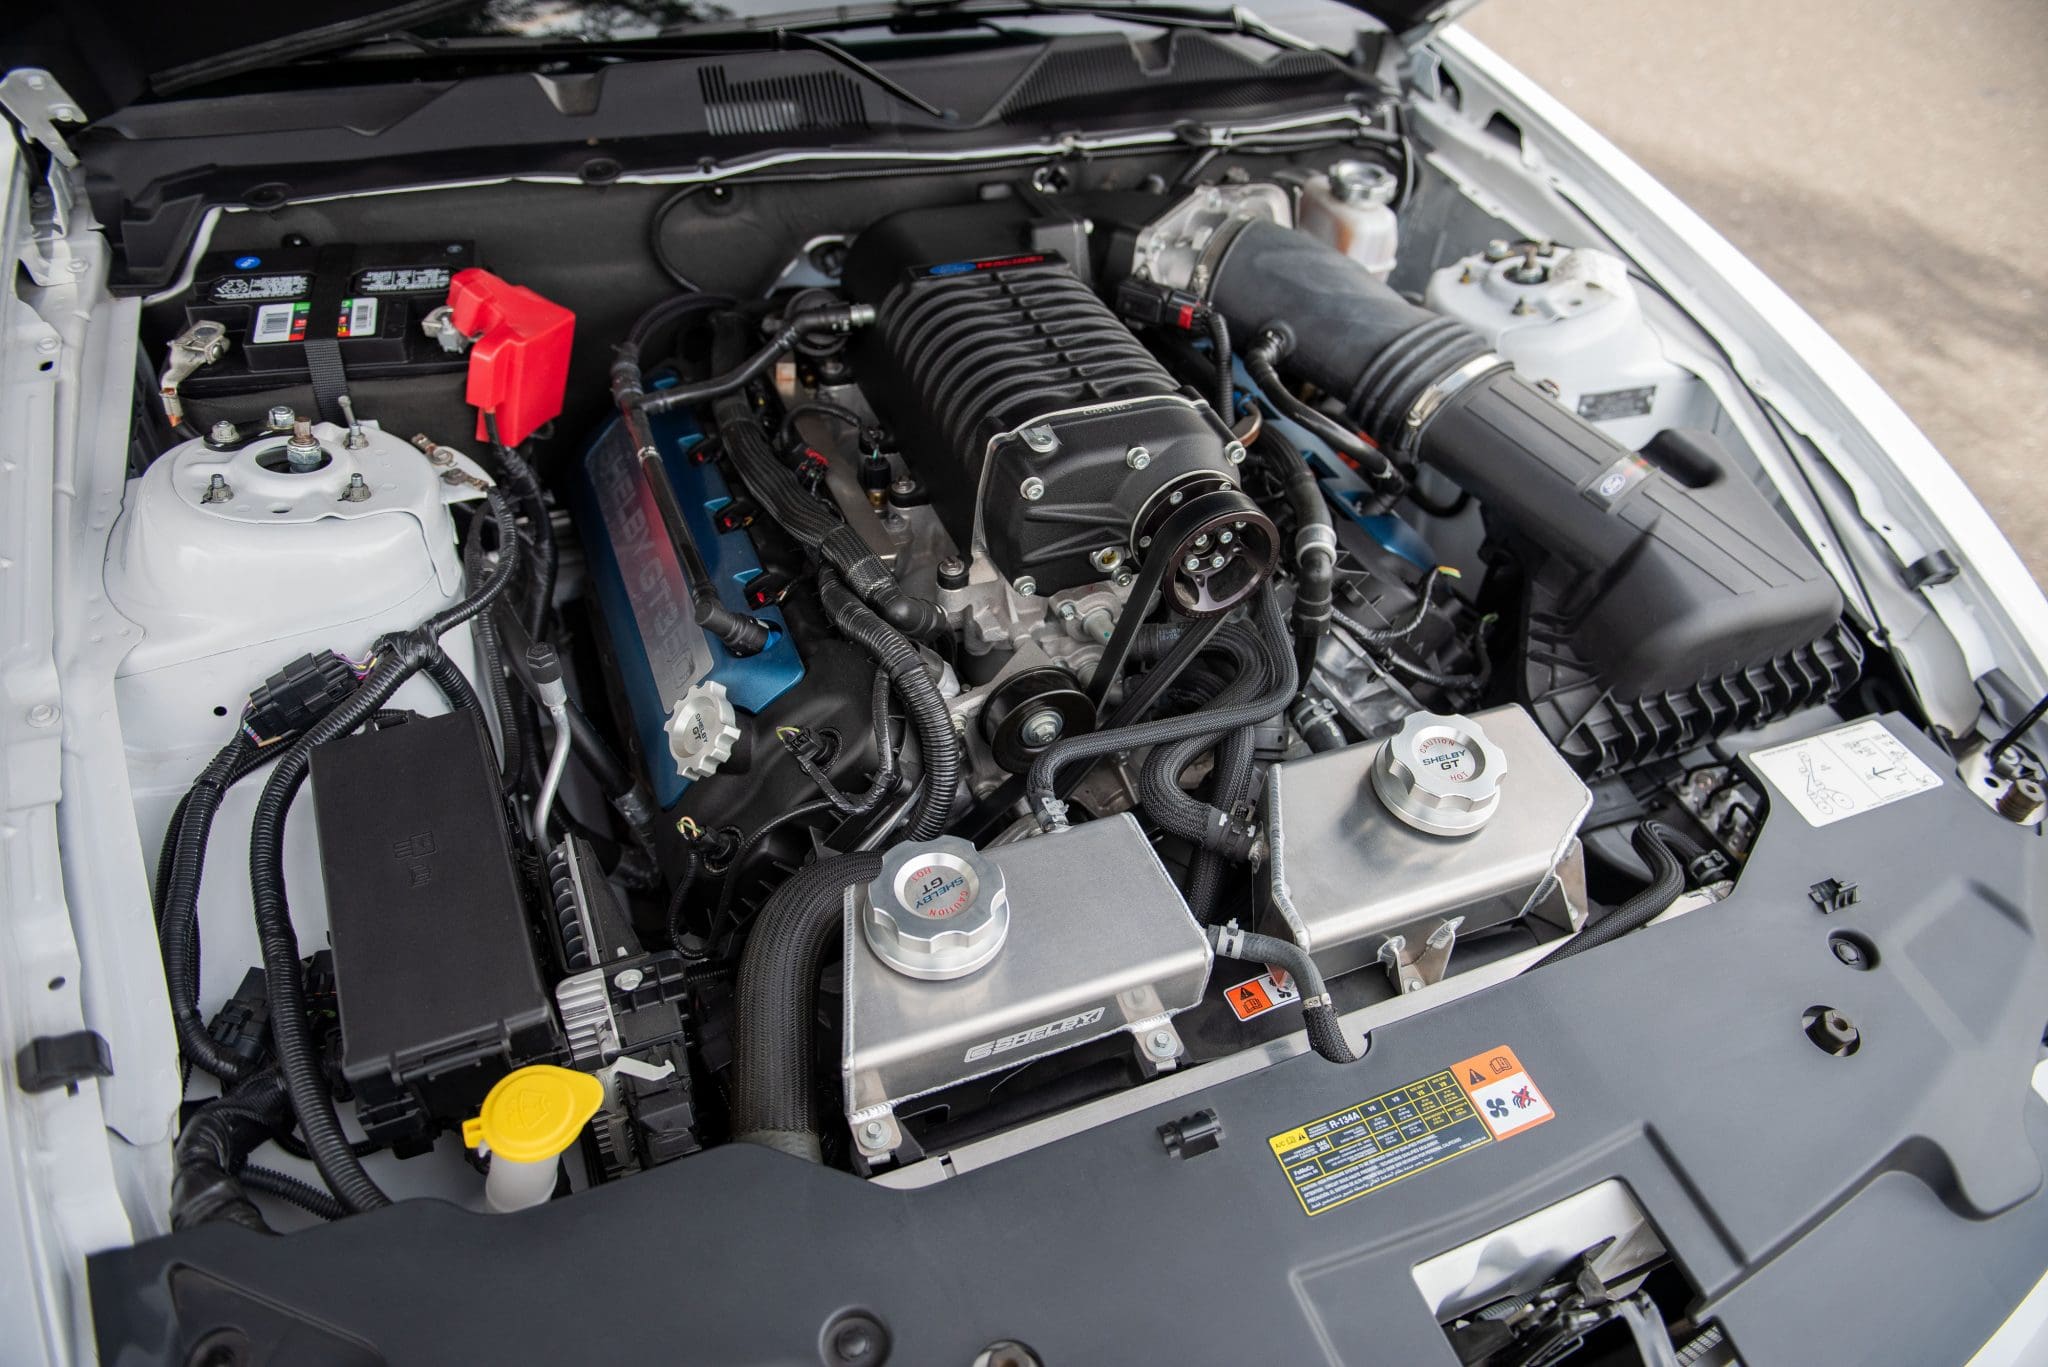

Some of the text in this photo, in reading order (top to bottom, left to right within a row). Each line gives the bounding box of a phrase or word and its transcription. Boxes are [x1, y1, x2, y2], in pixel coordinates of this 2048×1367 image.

[601, 440, 656, 557] HELBY
[692, 726, 702, 741] GT
[695, 713, 708, 743] SHELBY
[1420, 737, 1456, 754] CAUTION
[1422, 749, 1467, 766] SHELBY
[1440, 759, 1460, 771] GT
[1450, 771, 1469, 782] HOT
[912, 866, 932, 882] HOT
[915, 876, 965, 910] SHELBY
[922, 876, 943, 895] GT
[929, 890, 969, 917] CAUTION
[990, 1010, 1098, 1055] SHELBY
[1329, 1111, 1360, 1129] R-134A
